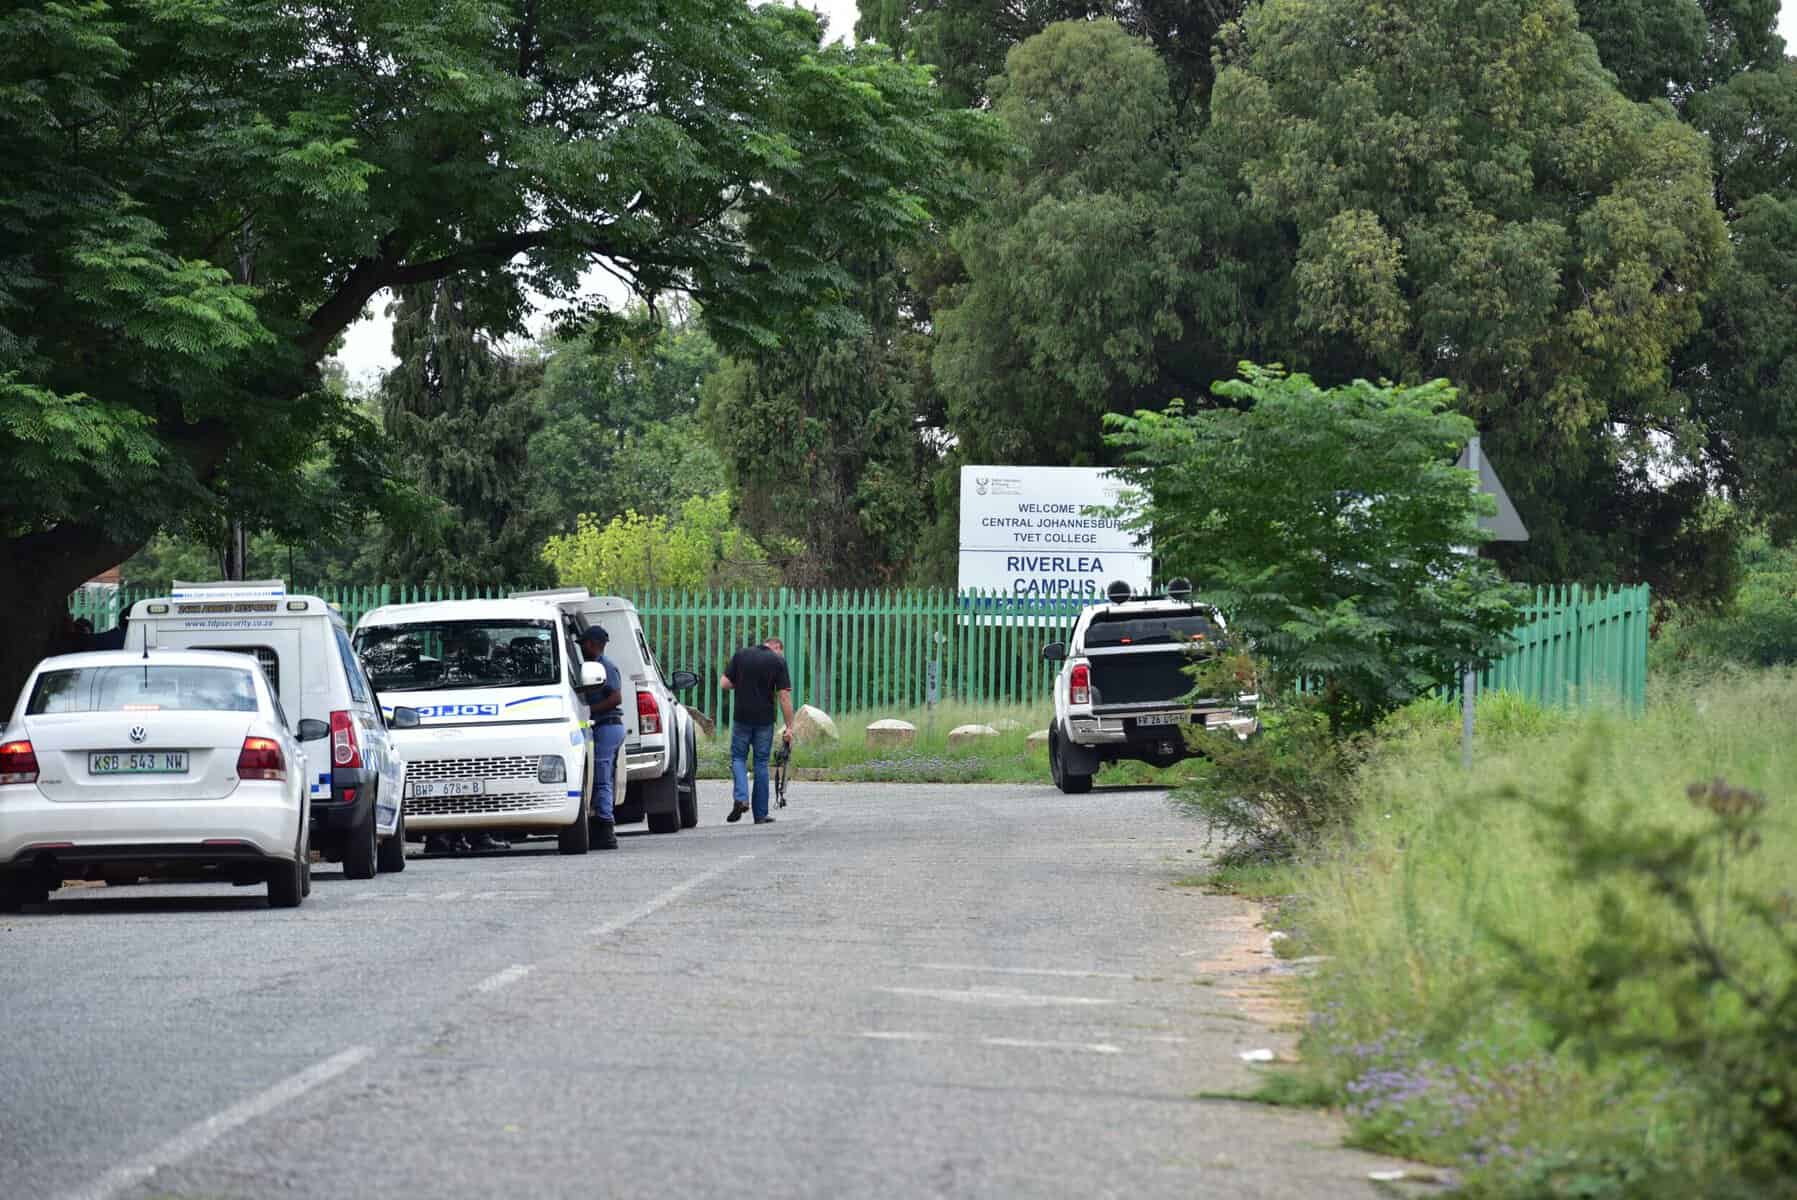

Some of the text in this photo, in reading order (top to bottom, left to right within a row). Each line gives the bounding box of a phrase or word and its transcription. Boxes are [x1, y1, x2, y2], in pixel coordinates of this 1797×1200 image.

[1018, 503, 1075, 513] WELCOME
[982, 517, 1033, 528] CENTRAL
[1013, 532, 1097, 543] TVET COLLEGE
[1007, 556, 1104, 572] RIVERLEA
[1013, 578, 1096, 594] CAMPUS
[130, 754, 155, 768] 543
[166, 754, 183, 768] NW
[443, 784, 461, 794] 678
[473, 782, 479, 792] B
